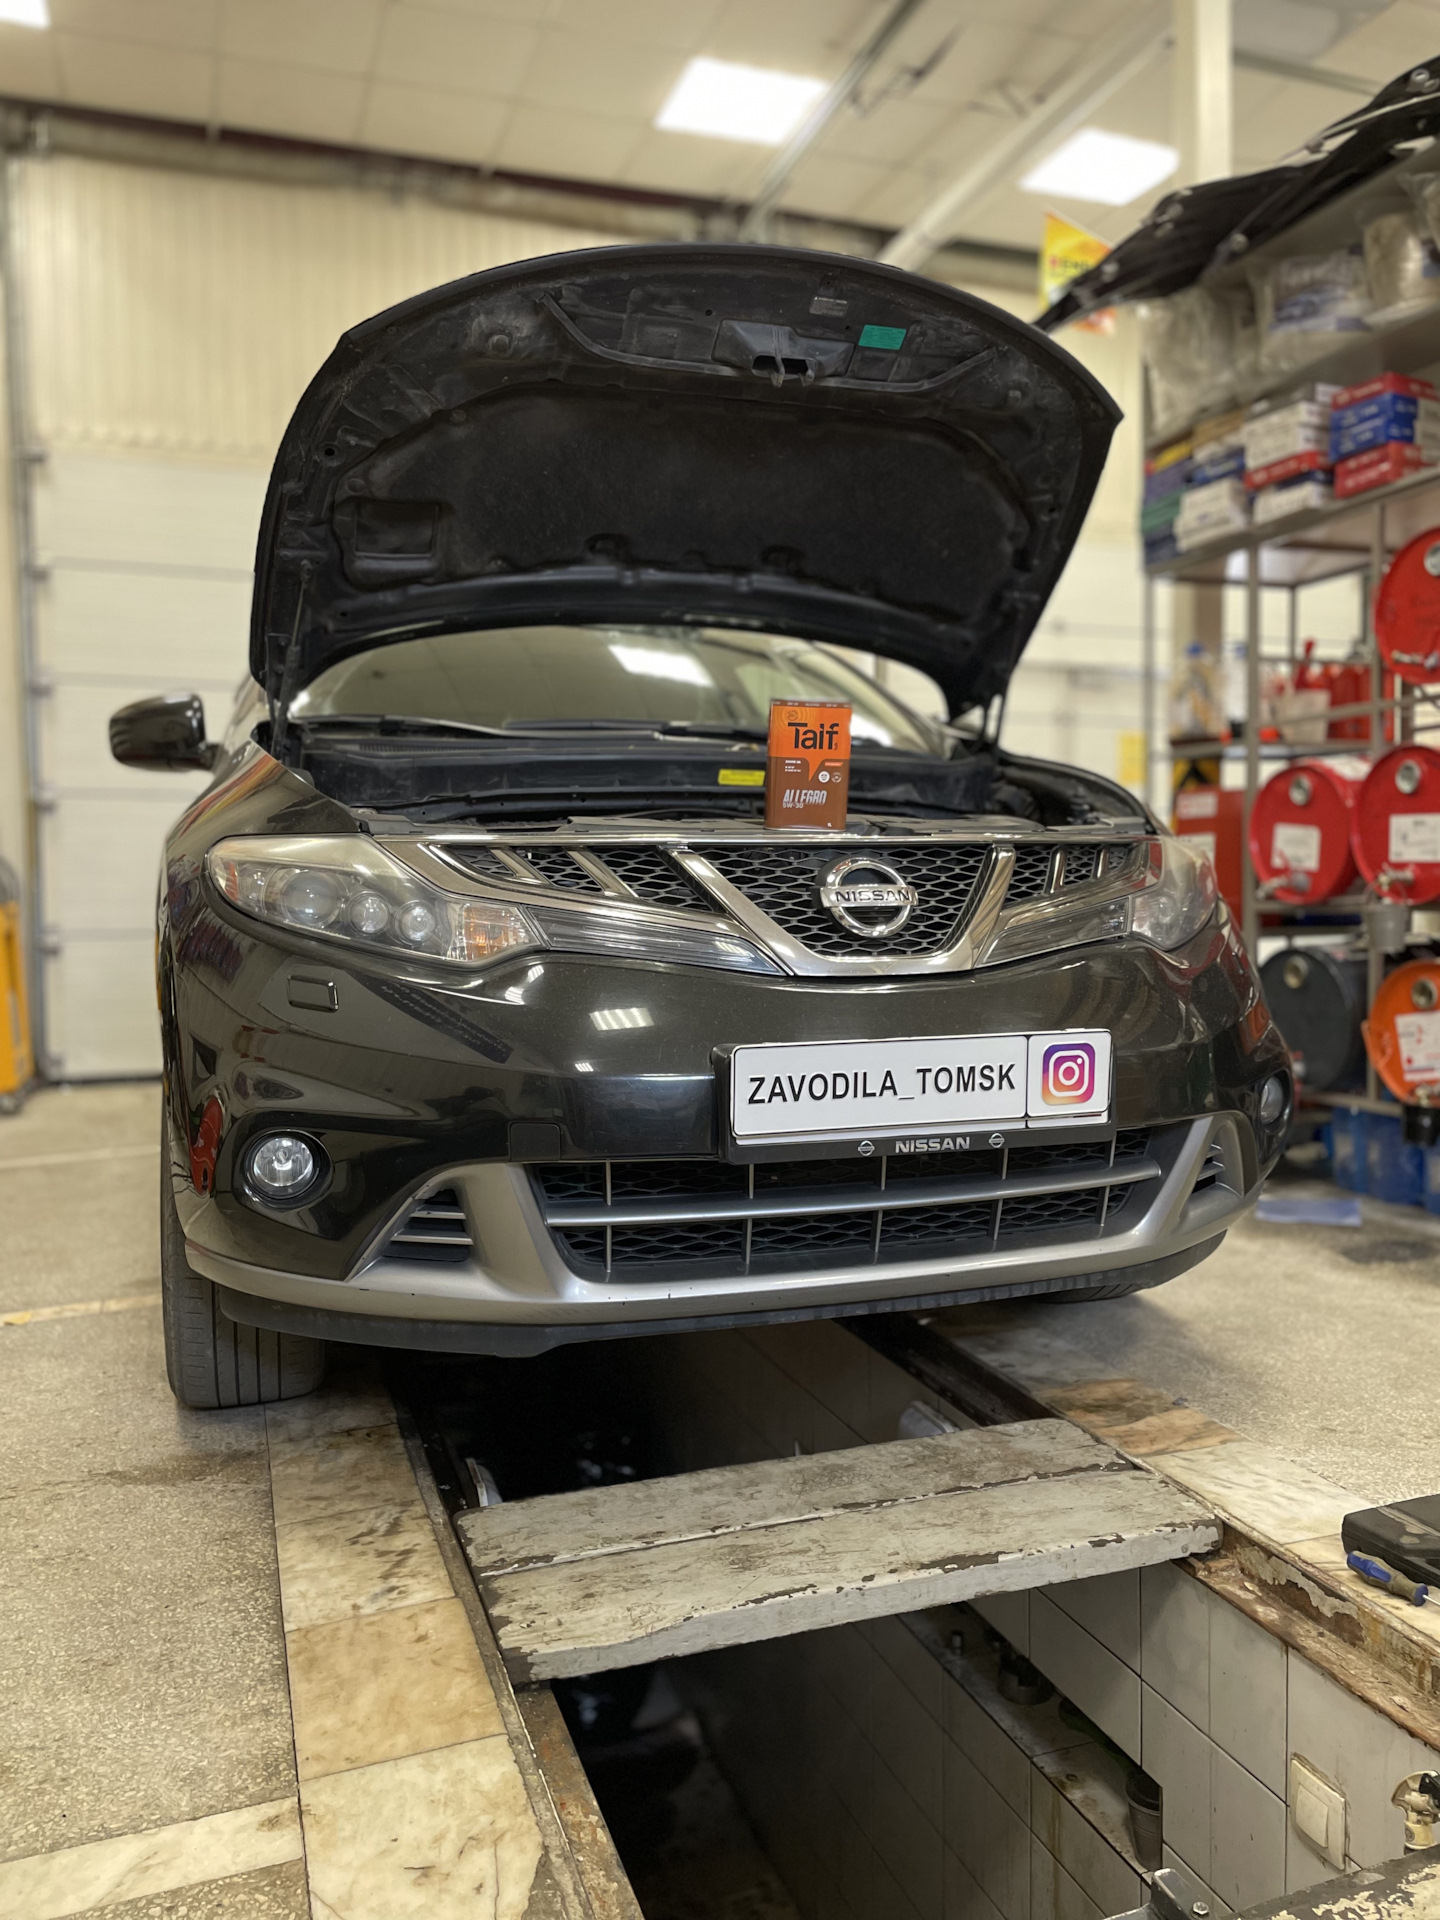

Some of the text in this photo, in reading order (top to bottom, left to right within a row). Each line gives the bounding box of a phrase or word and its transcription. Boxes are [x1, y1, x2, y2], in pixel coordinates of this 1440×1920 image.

[787, 722, 839, 750] Taif
[783, 789, 827, 805] ALLEGRO
[834, 889, 911, 903] NISSAN
[747, 1063, 1016, 1105] ZAVODILA_TOMSK
[894, 1136, 971, 1154] NISSAN
